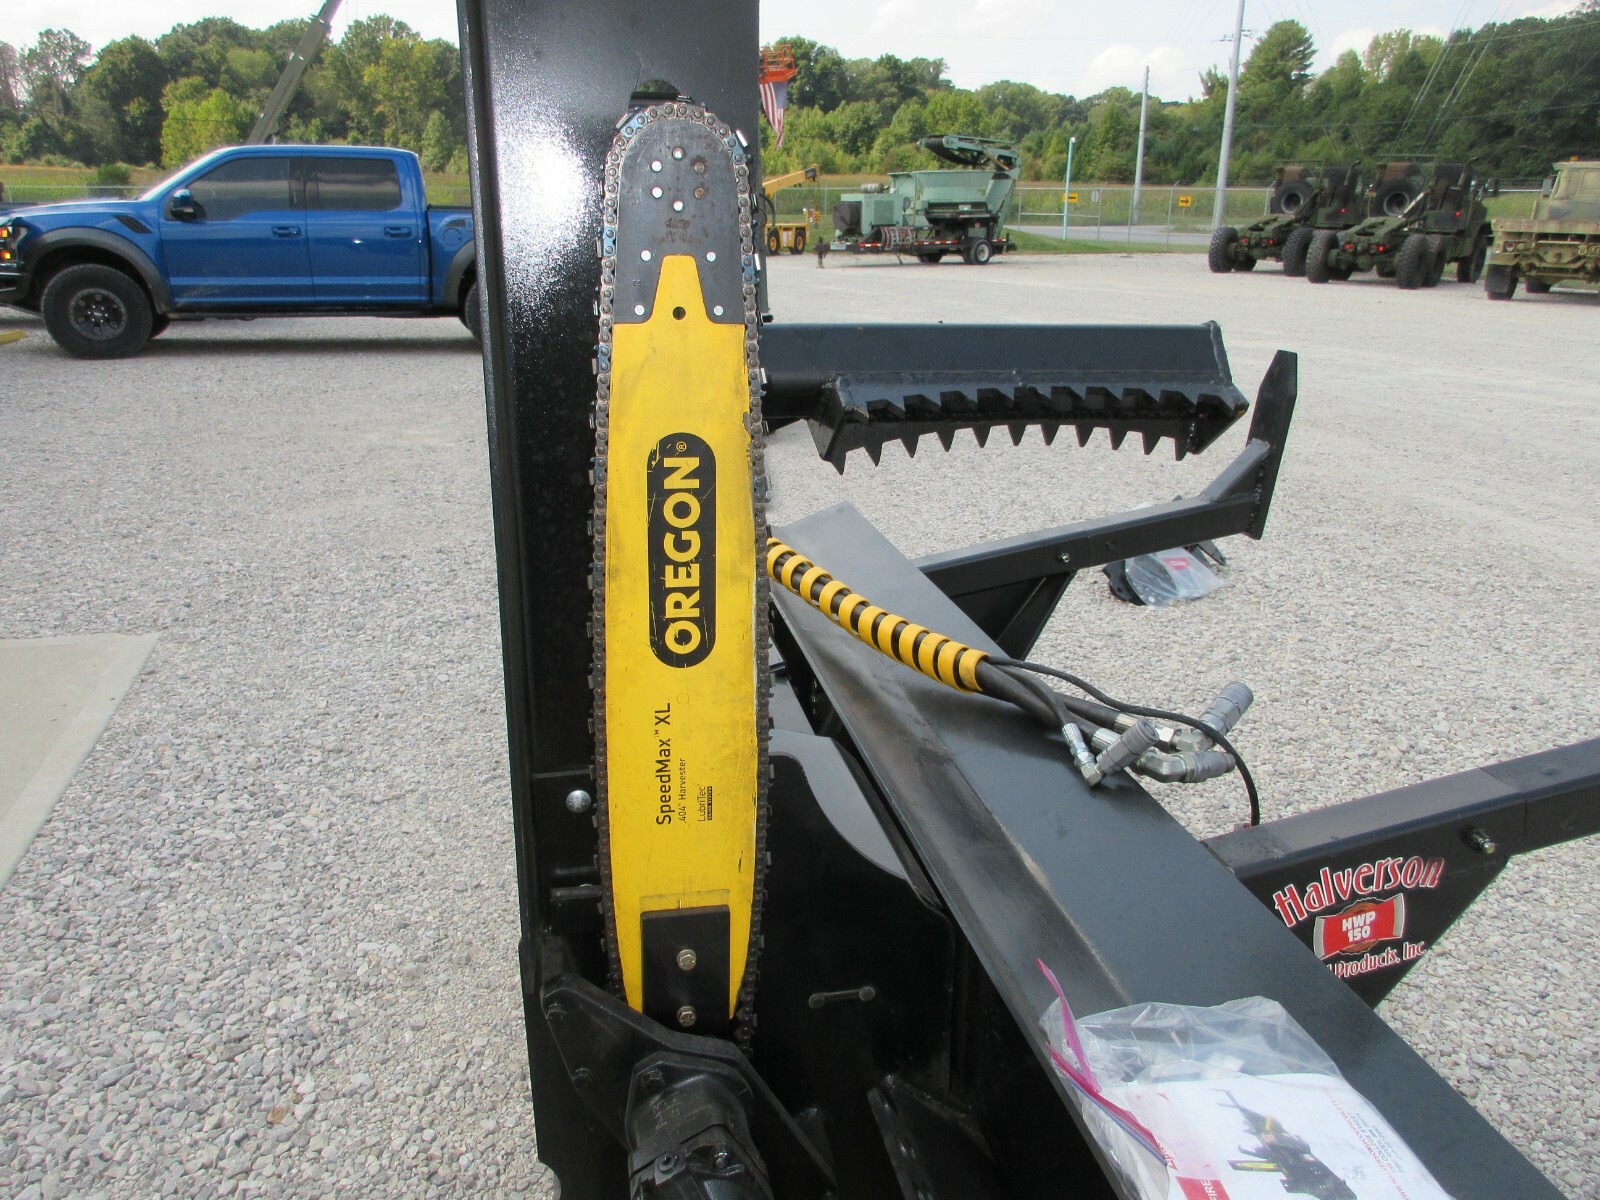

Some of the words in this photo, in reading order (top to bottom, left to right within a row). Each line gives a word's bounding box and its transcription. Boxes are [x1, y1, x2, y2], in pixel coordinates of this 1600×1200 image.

[654, 702, 671, 726] XL
[678, 758, 686, 800] Harvester
[1272, 856, 1445, 928] Halverson
[1342, 911, 1376, 931] HWP
[1347, 925, 1371, 942] 150
